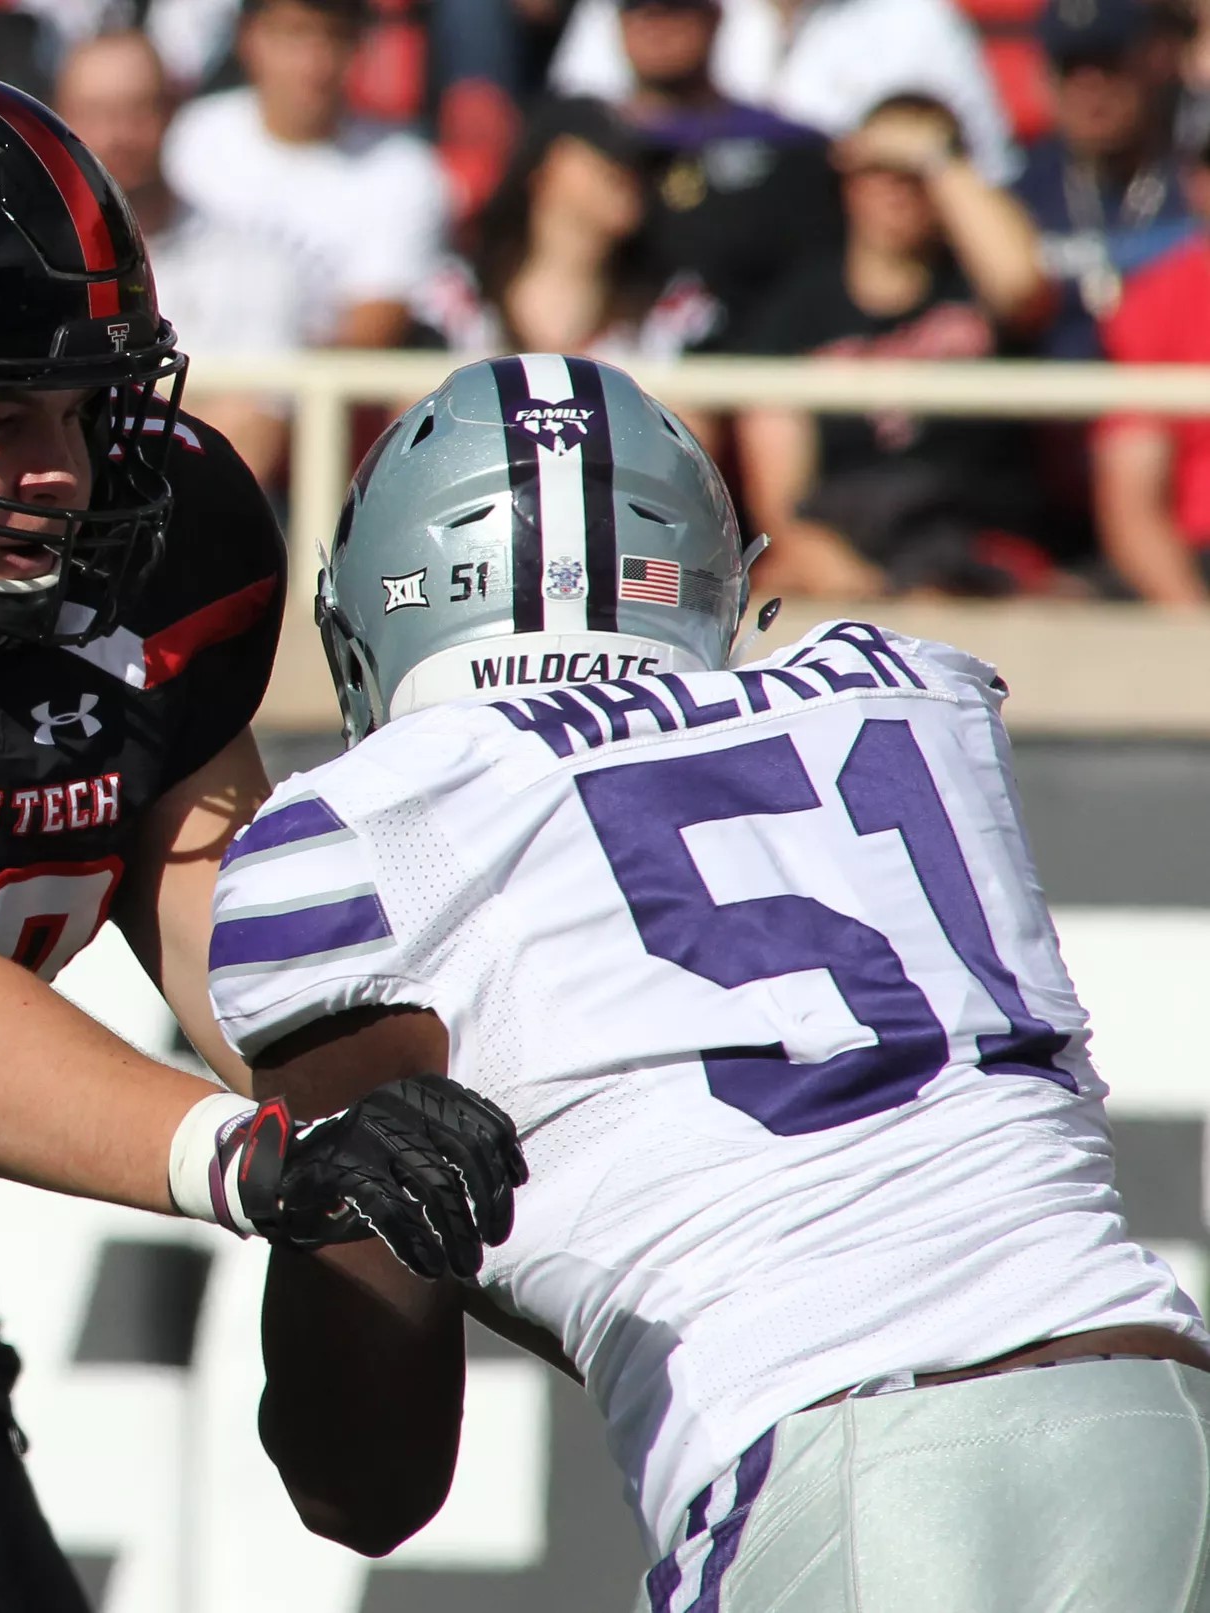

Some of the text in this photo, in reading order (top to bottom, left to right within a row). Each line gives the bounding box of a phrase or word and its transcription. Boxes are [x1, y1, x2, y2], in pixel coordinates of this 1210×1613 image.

[515, 408, 595, 422] FAMILY
[381, 566, 430, 615] XII
[450, 561, 489, 602] 51
[470, 652, 660, 690] WILDCATS
[11, 772, 121, 836] TECH
[573, 718, 1080, 1137] 51
